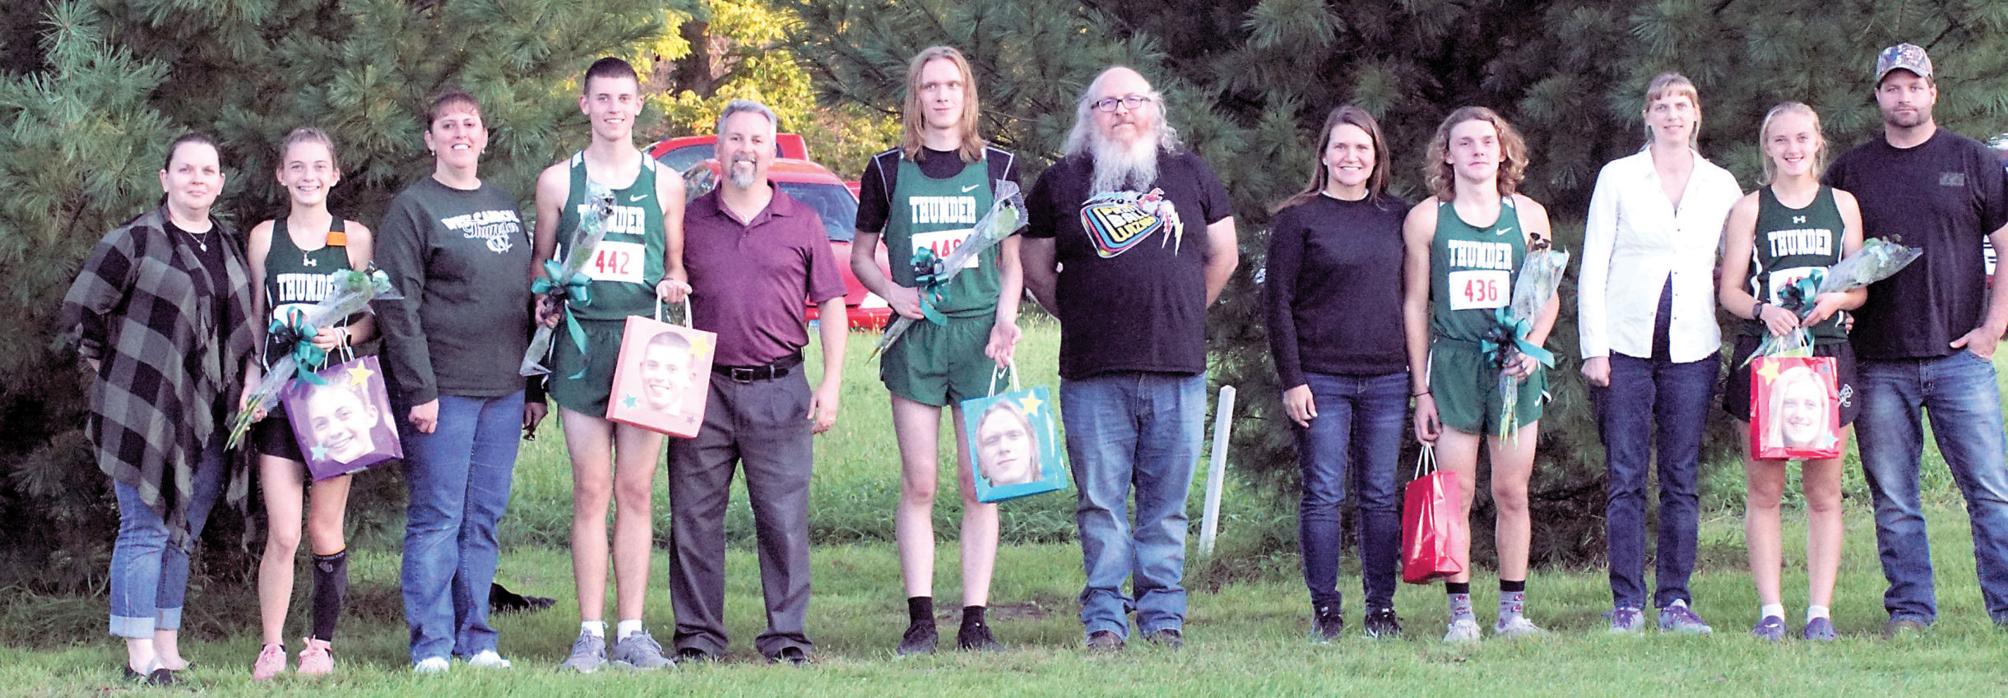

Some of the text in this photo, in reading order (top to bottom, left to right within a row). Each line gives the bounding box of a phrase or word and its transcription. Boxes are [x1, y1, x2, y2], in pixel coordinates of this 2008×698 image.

[908, 195, 976, 224] THUNDER
[1447, 239, 1513, 270] THUNDER
[1767, 228, 1833, 258] THUNDER
[595, 249, 630, 275] 442
[1464, 279, 1499, 303] 436
